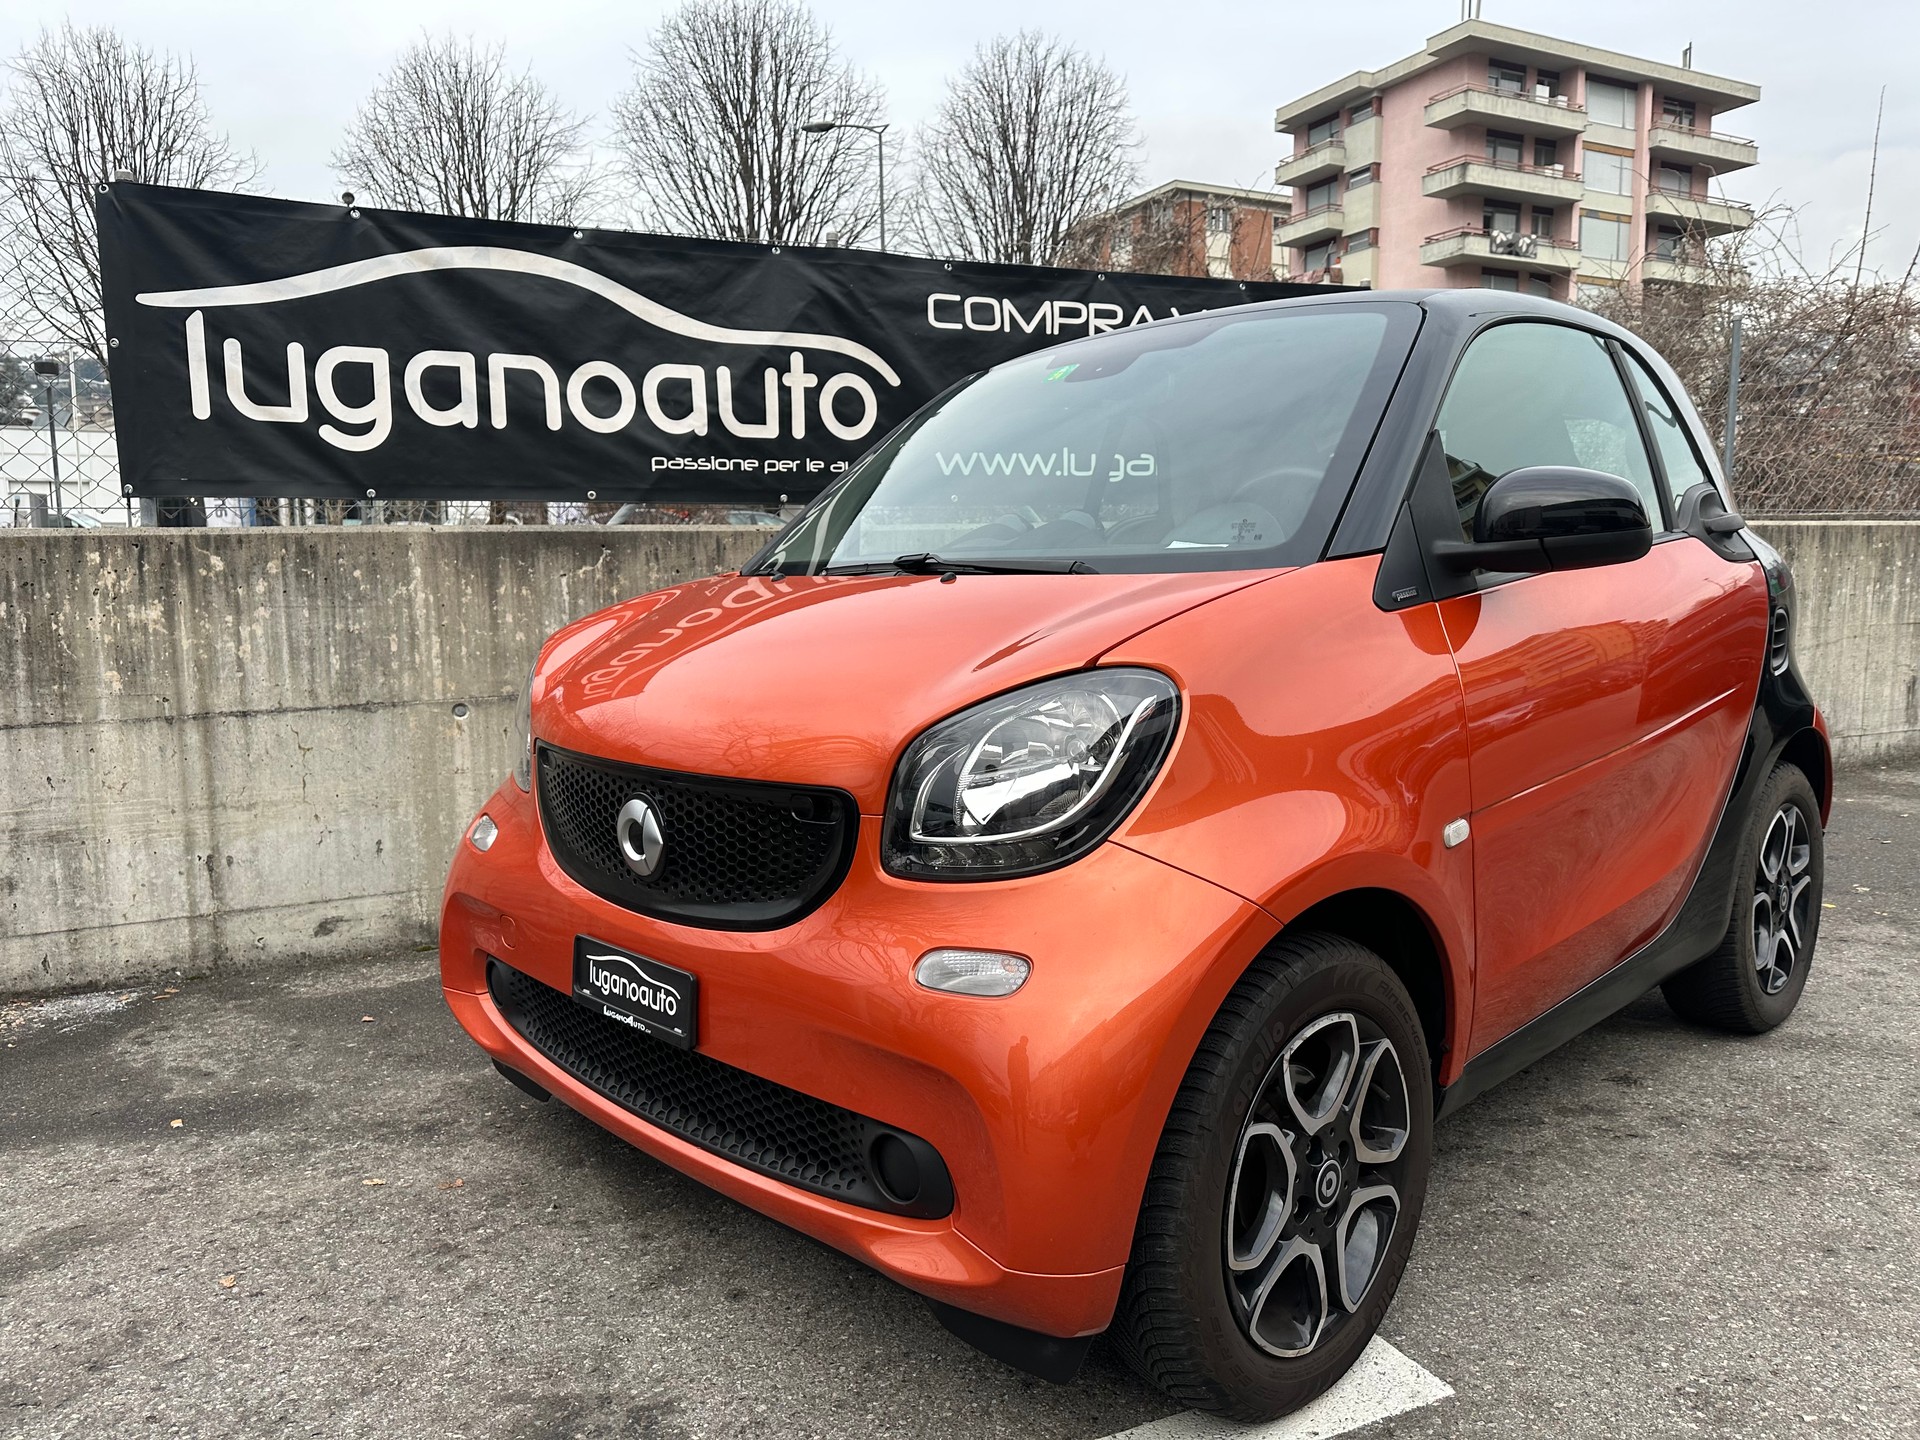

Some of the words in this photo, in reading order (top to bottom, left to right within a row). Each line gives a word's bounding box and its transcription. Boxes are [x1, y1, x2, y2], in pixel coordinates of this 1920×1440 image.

[927, 293, 1206, 336] COMPRA
[184, 309, 880, 453] luganoauto
[651, 456, 759, 472] passione
[764, 459, 801, 474] per
[806, 458, 825, 472] le
[936, 447, 1158, 482] www.luga
[589, 960, 677, 1016] luganoauto
[1233, 1021, 1285, 1116] apollo
